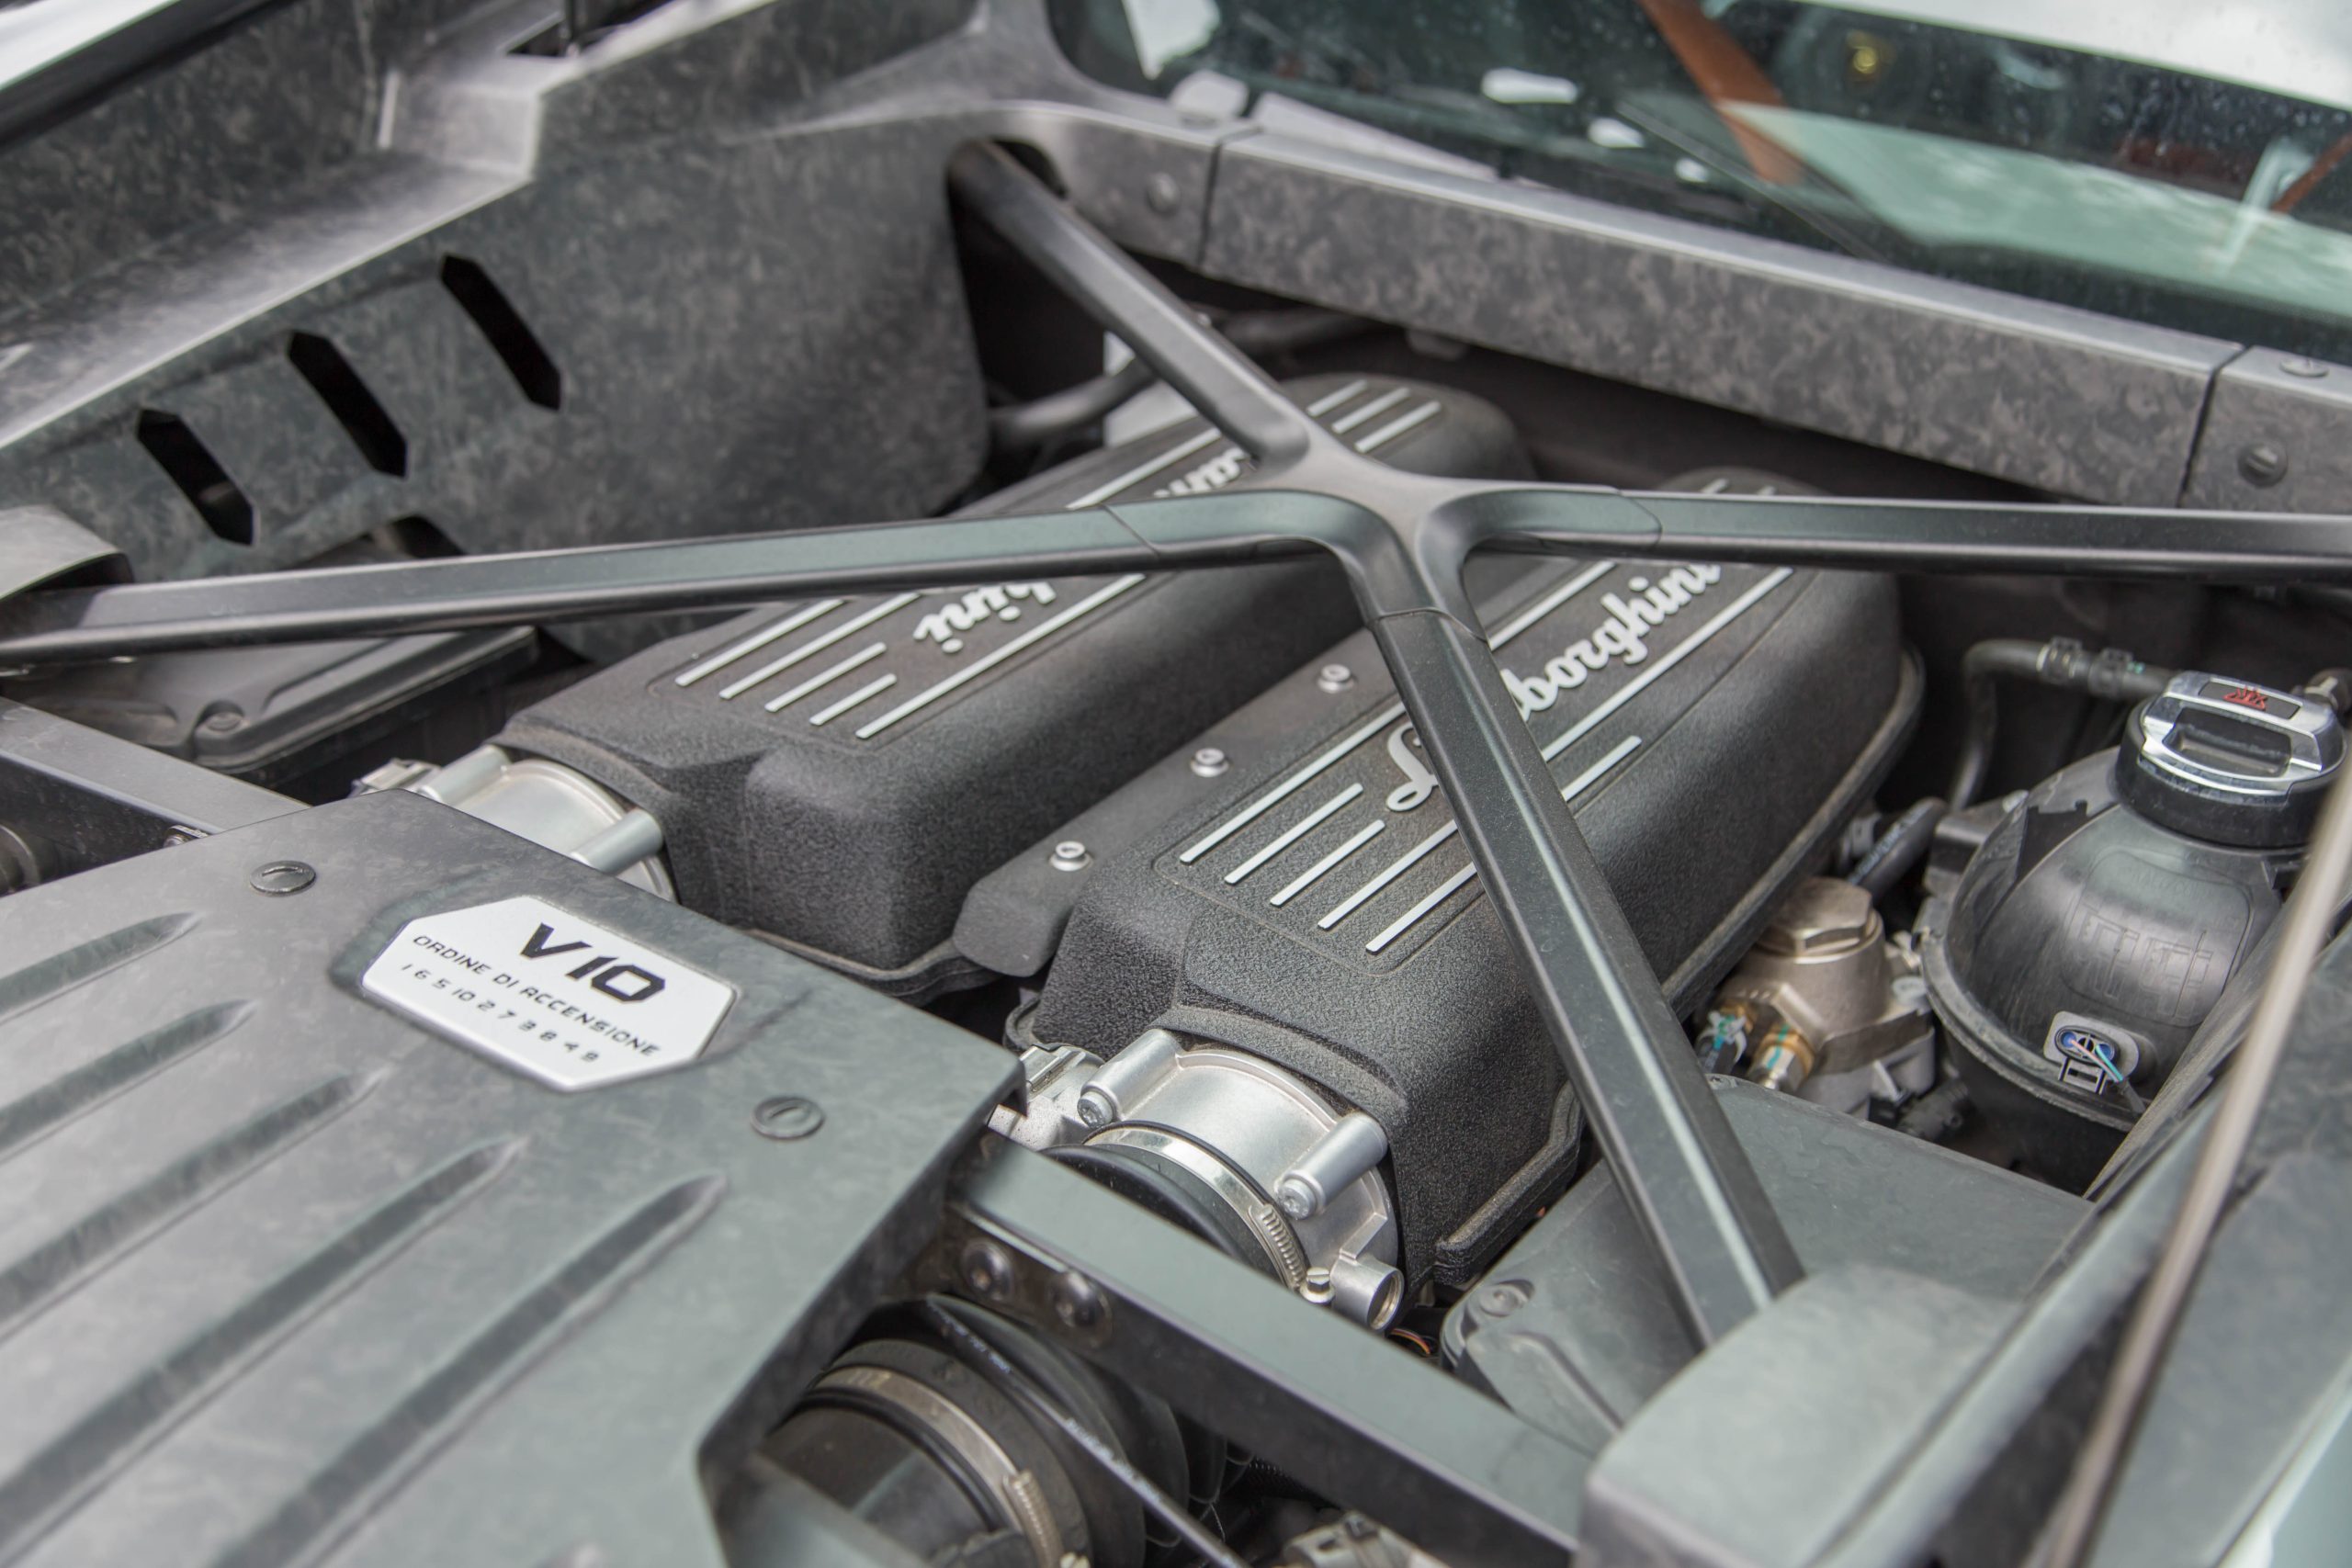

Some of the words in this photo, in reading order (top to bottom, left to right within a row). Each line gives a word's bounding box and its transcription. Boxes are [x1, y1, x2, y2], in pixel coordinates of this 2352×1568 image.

[413, 935, 492, 975] ORDINE
[492, 973, 519, 988] DI
[519, 987, 660, 1055] ACCENSIONE
[519, 921, 666, 1004] V10
